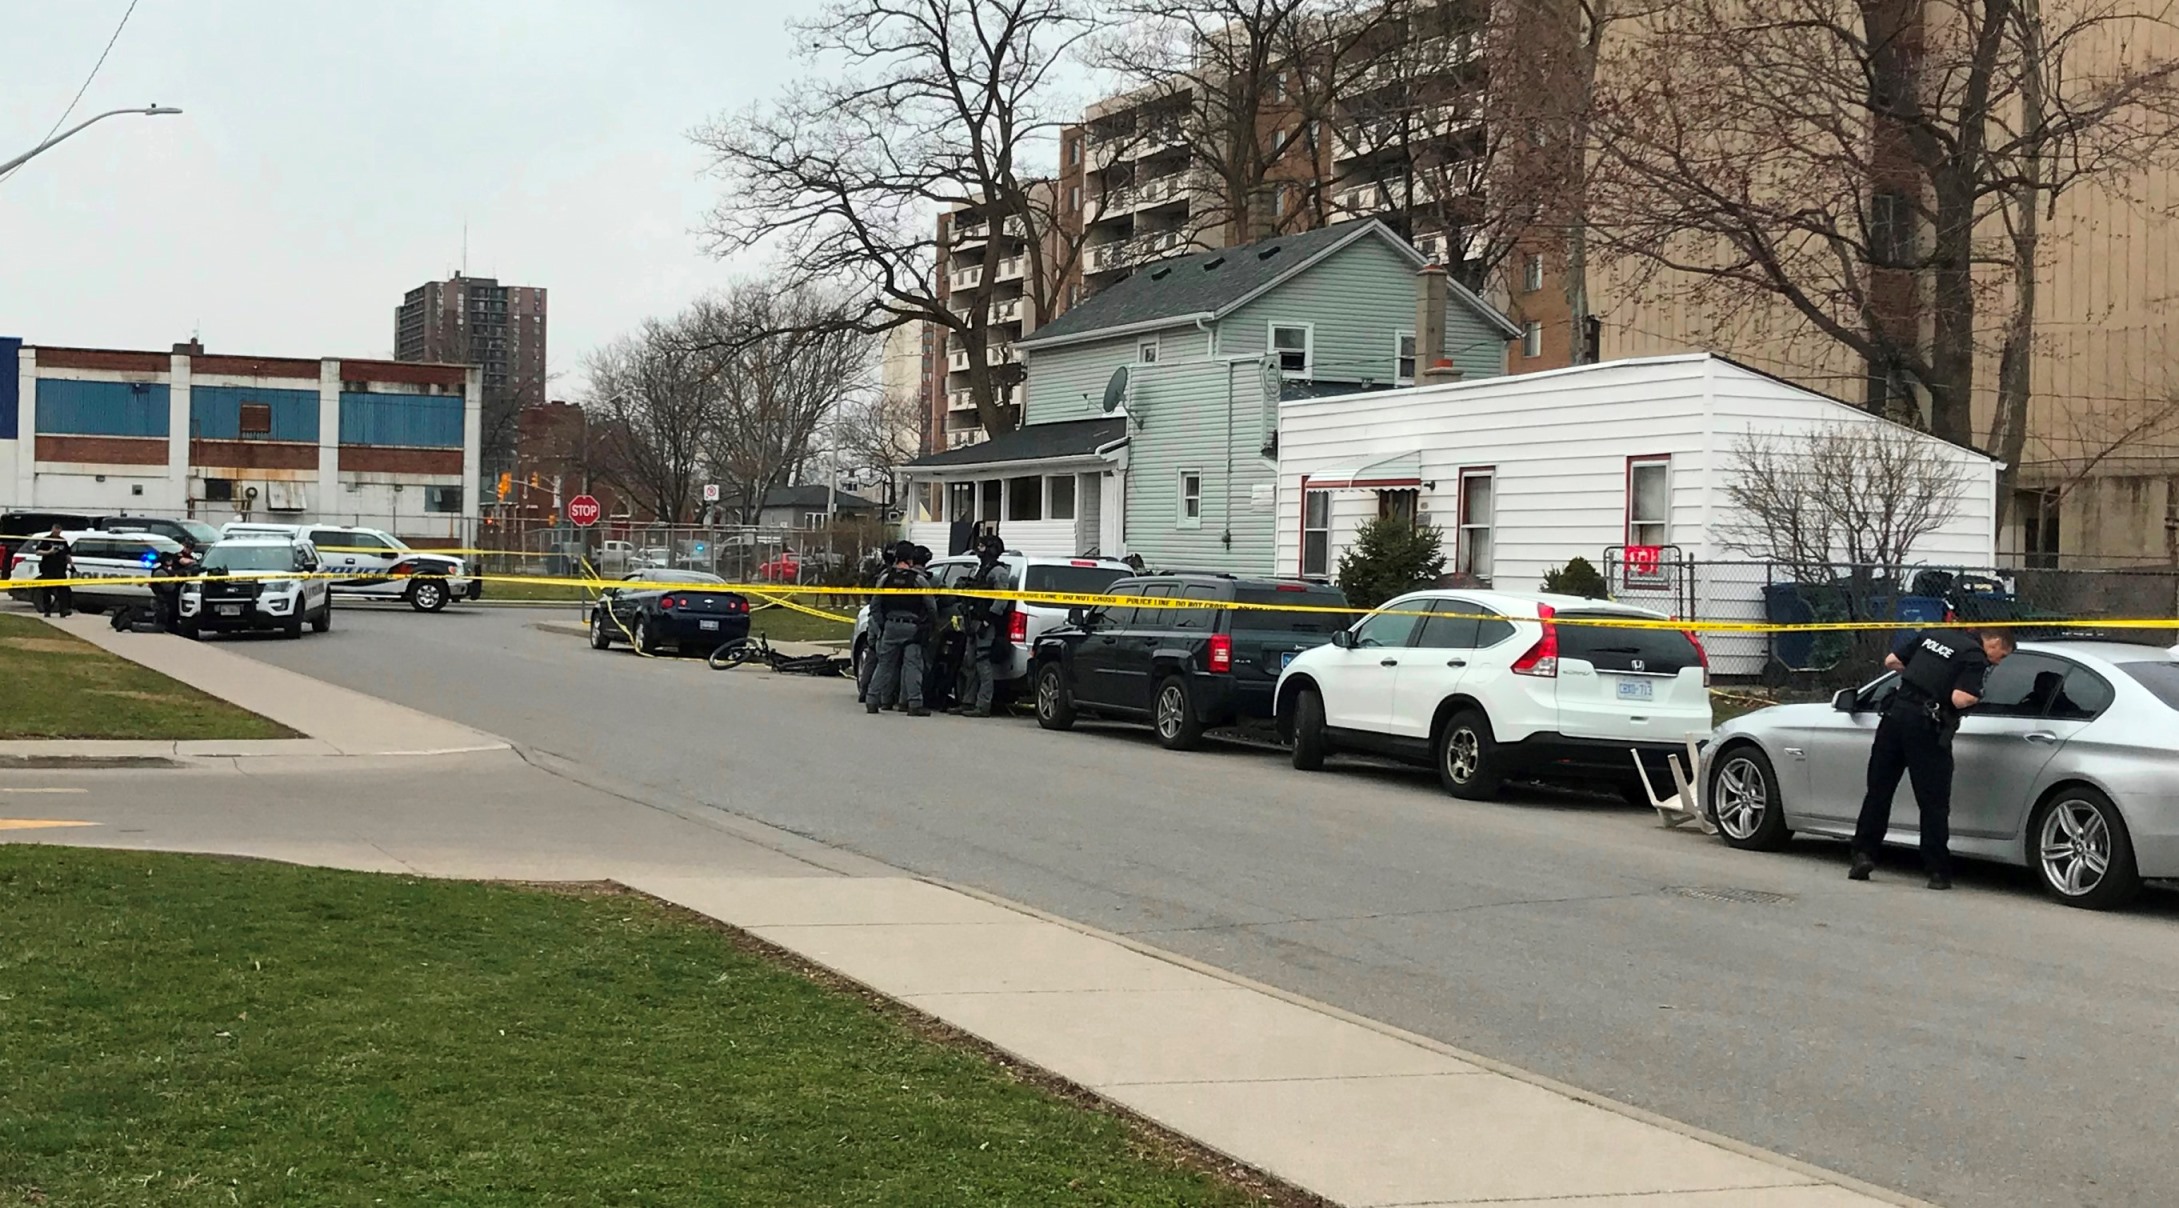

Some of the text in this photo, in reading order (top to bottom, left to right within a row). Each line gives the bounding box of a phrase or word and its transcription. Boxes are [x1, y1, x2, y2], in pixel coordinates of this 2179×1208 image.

[571, 504, 597, 517] STOP
[1126, 597, 1153, 605] POLICE
[1154, 599, 1171, 607] LINE
[1921, 638, 1955, 659] POLICE
